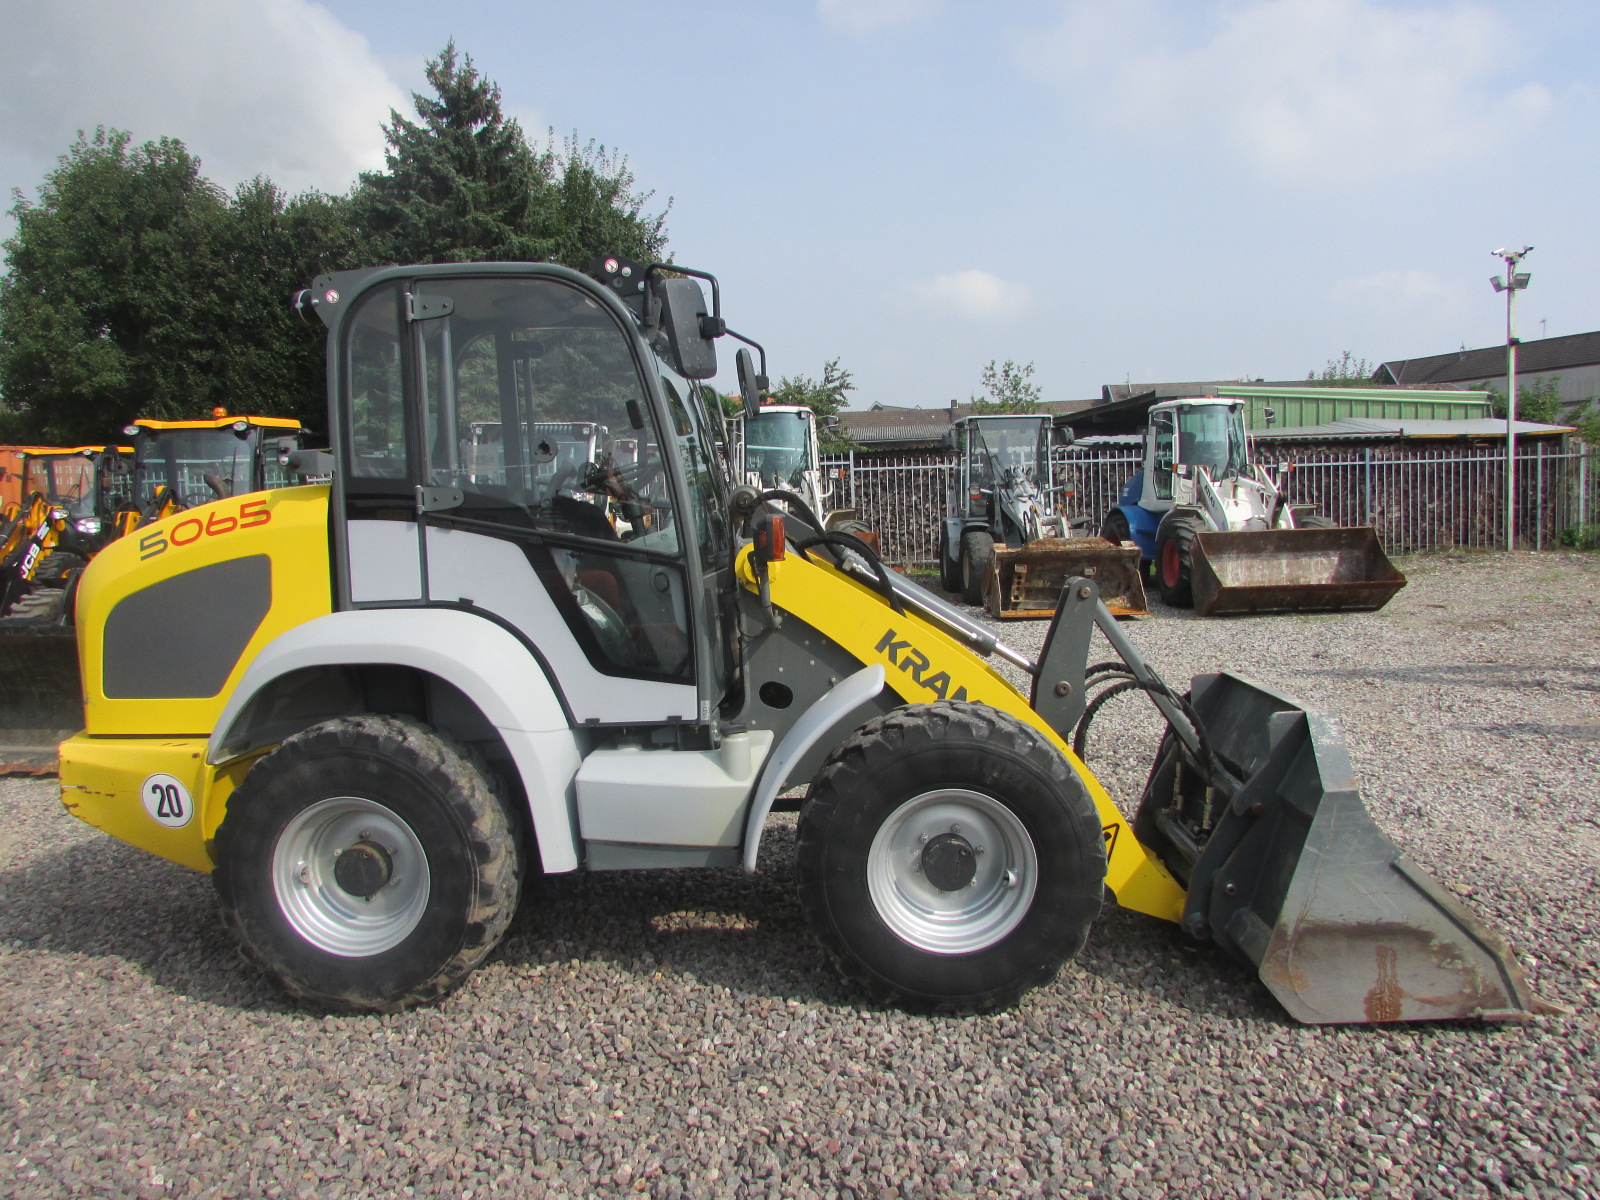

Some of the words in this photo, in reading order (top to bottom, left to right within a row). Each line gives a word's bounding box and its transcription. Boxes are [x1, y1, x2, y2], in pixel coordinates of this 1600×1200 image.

[140, 499, 271, 561] 5065
[20, 543, 40, 579] JCB
[151, 783, 184, 818] 20
